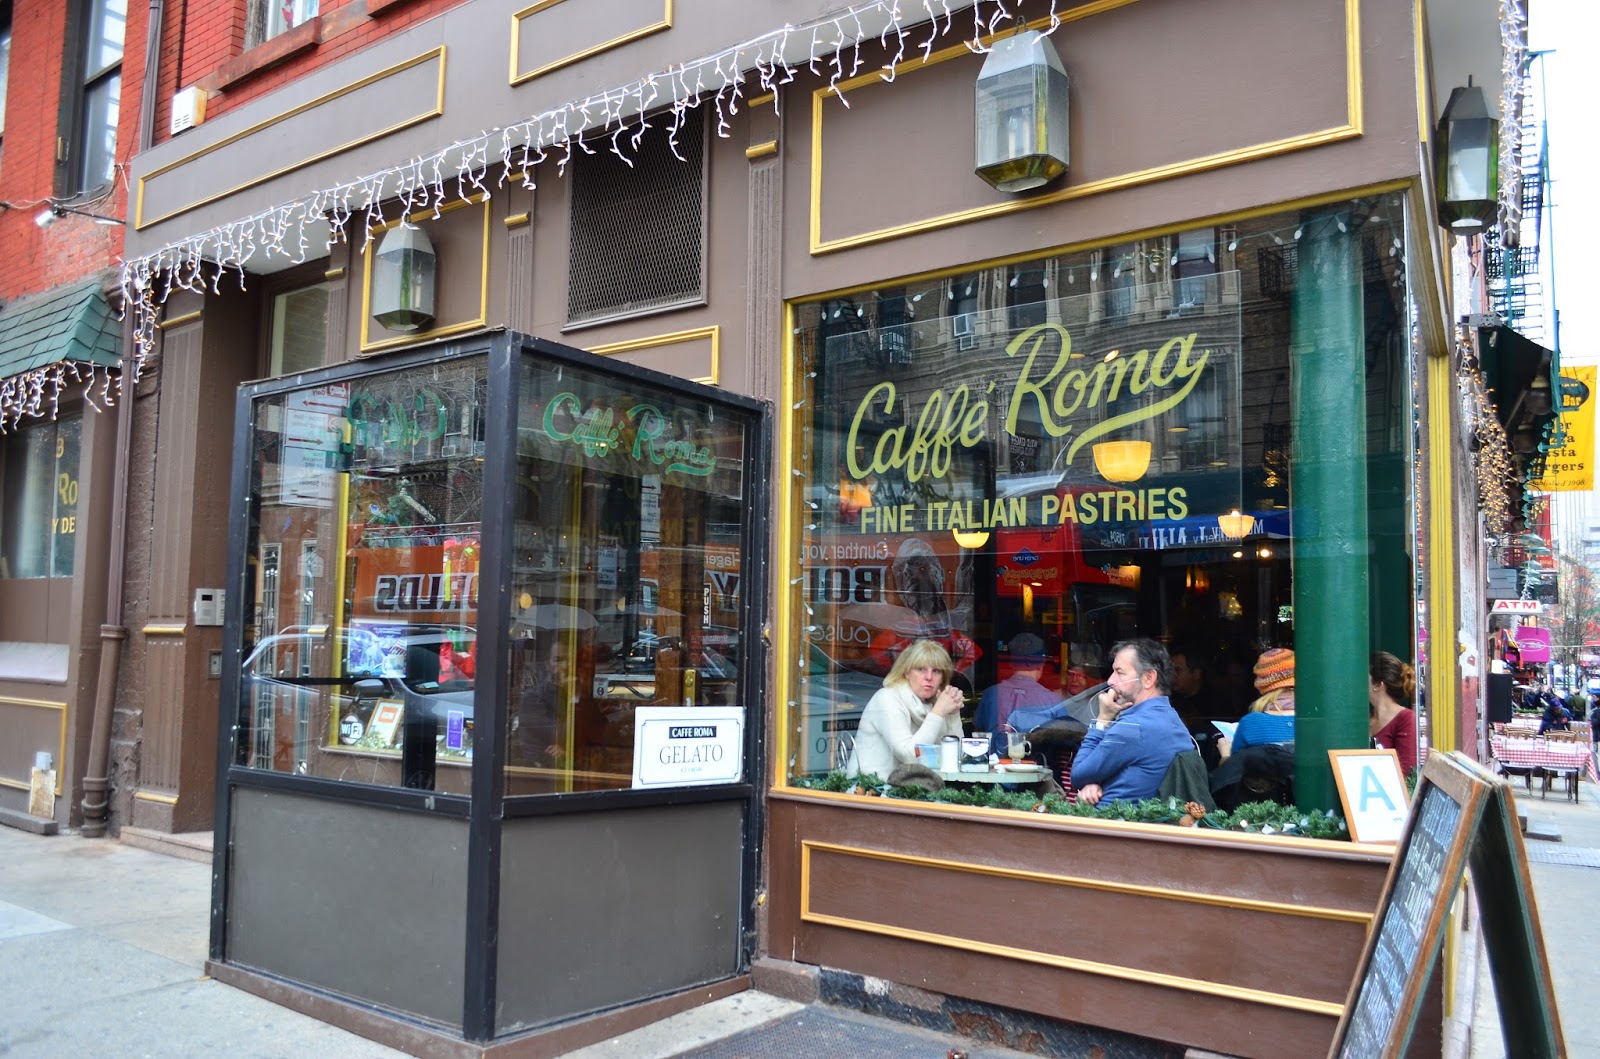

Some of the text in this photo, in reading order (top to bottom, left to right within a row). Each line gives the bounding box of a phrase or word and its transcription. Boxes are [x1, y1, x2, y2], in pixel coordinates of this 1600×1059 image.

[1005, 322, 1211, 465] Roma
[1563, 394, 1581, 407] Bar
[626, 404, 717, 476] Roma
[861, 487, 1188, 534] FINE ITALIAN PASTRIES
[1497, 601, 1537, 610] ATM
[671, 726, 714, 738] CAFFE ROMA
[659, 744, 723, 765] GELATO
[1359, 765, 1397, 812] A
